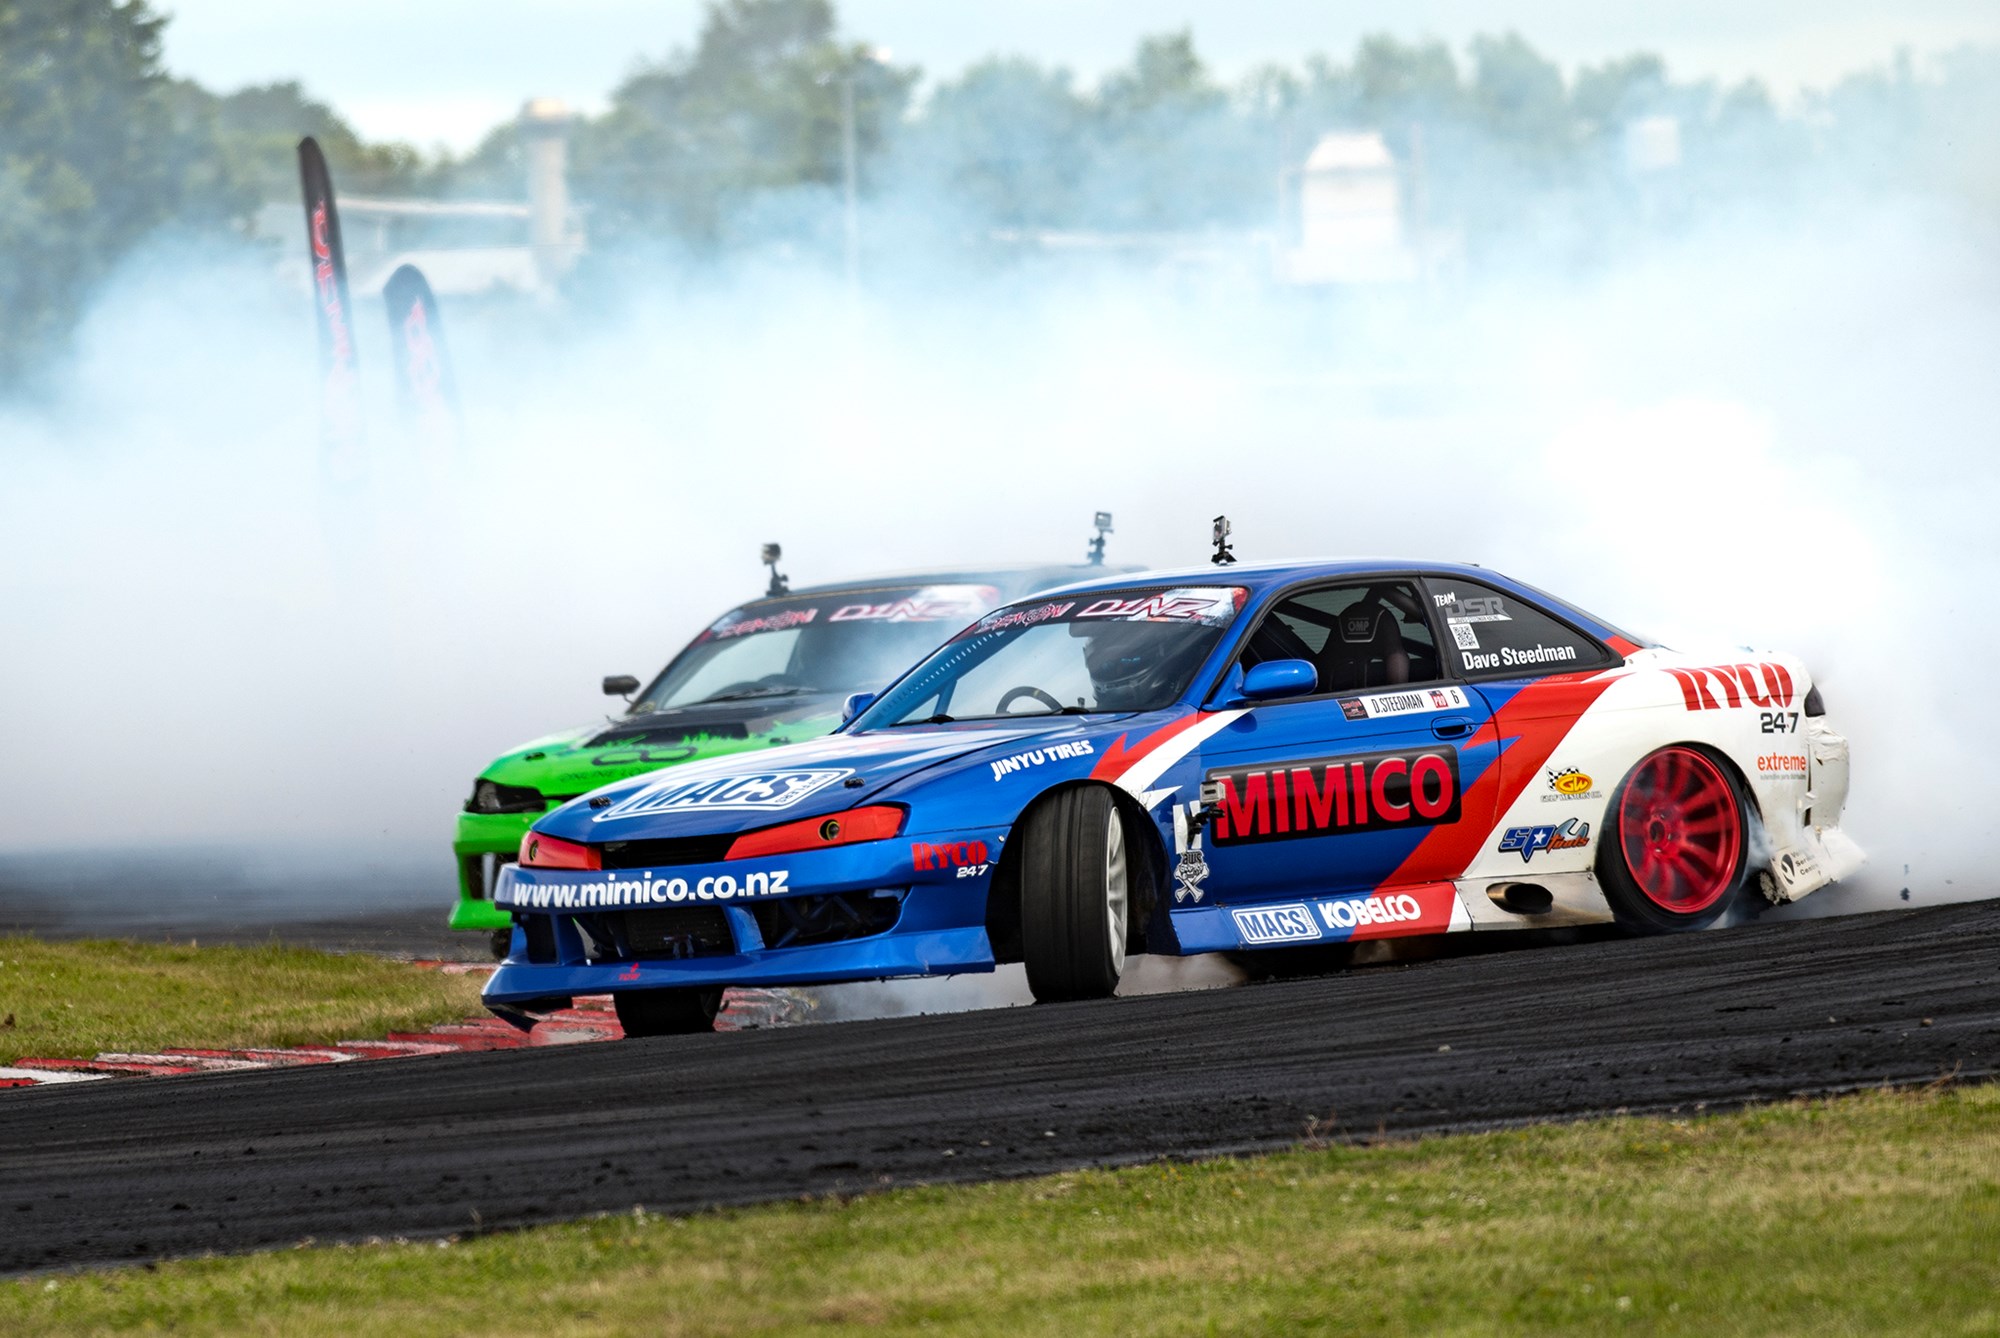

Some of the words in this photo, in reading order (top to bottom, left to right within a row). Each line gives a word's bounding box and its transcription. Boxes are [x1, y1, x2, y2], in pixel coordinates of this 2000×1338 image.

[1075, 594, 1220, 619] D1NZ
[1434, 592, 1456, 607] TEAM
[1347, 620, 1370, 632] OMP
[1461, 651, 1500, 670] Dave
[1500, 644, 1577, 666] Steedman
[1371, 693, 1425, 714] D.STEEDMAN
[1450, 689, 1460, 704] 6
[1659, 662, 1794, 711] RYCO
[990, 750, 1045, 782] JINYU
[1043, 740, 1094, 762] TIRES
[1757, 752, 1807, 771] extreme
[615, 773, 813, 814] MACS
[1211, 754, 1454, 839] MIMICO
[1559, 776, 1588, 792] GW
[911, 841, 988, 871] RYCO
[1498, 824, 1557, 863] SP
[513, 870, 789, 908] www.mimico.co.nz
[1238, 910, 1309, 939] MACS
[1317, 894, 1421, 929] KOBELCO
